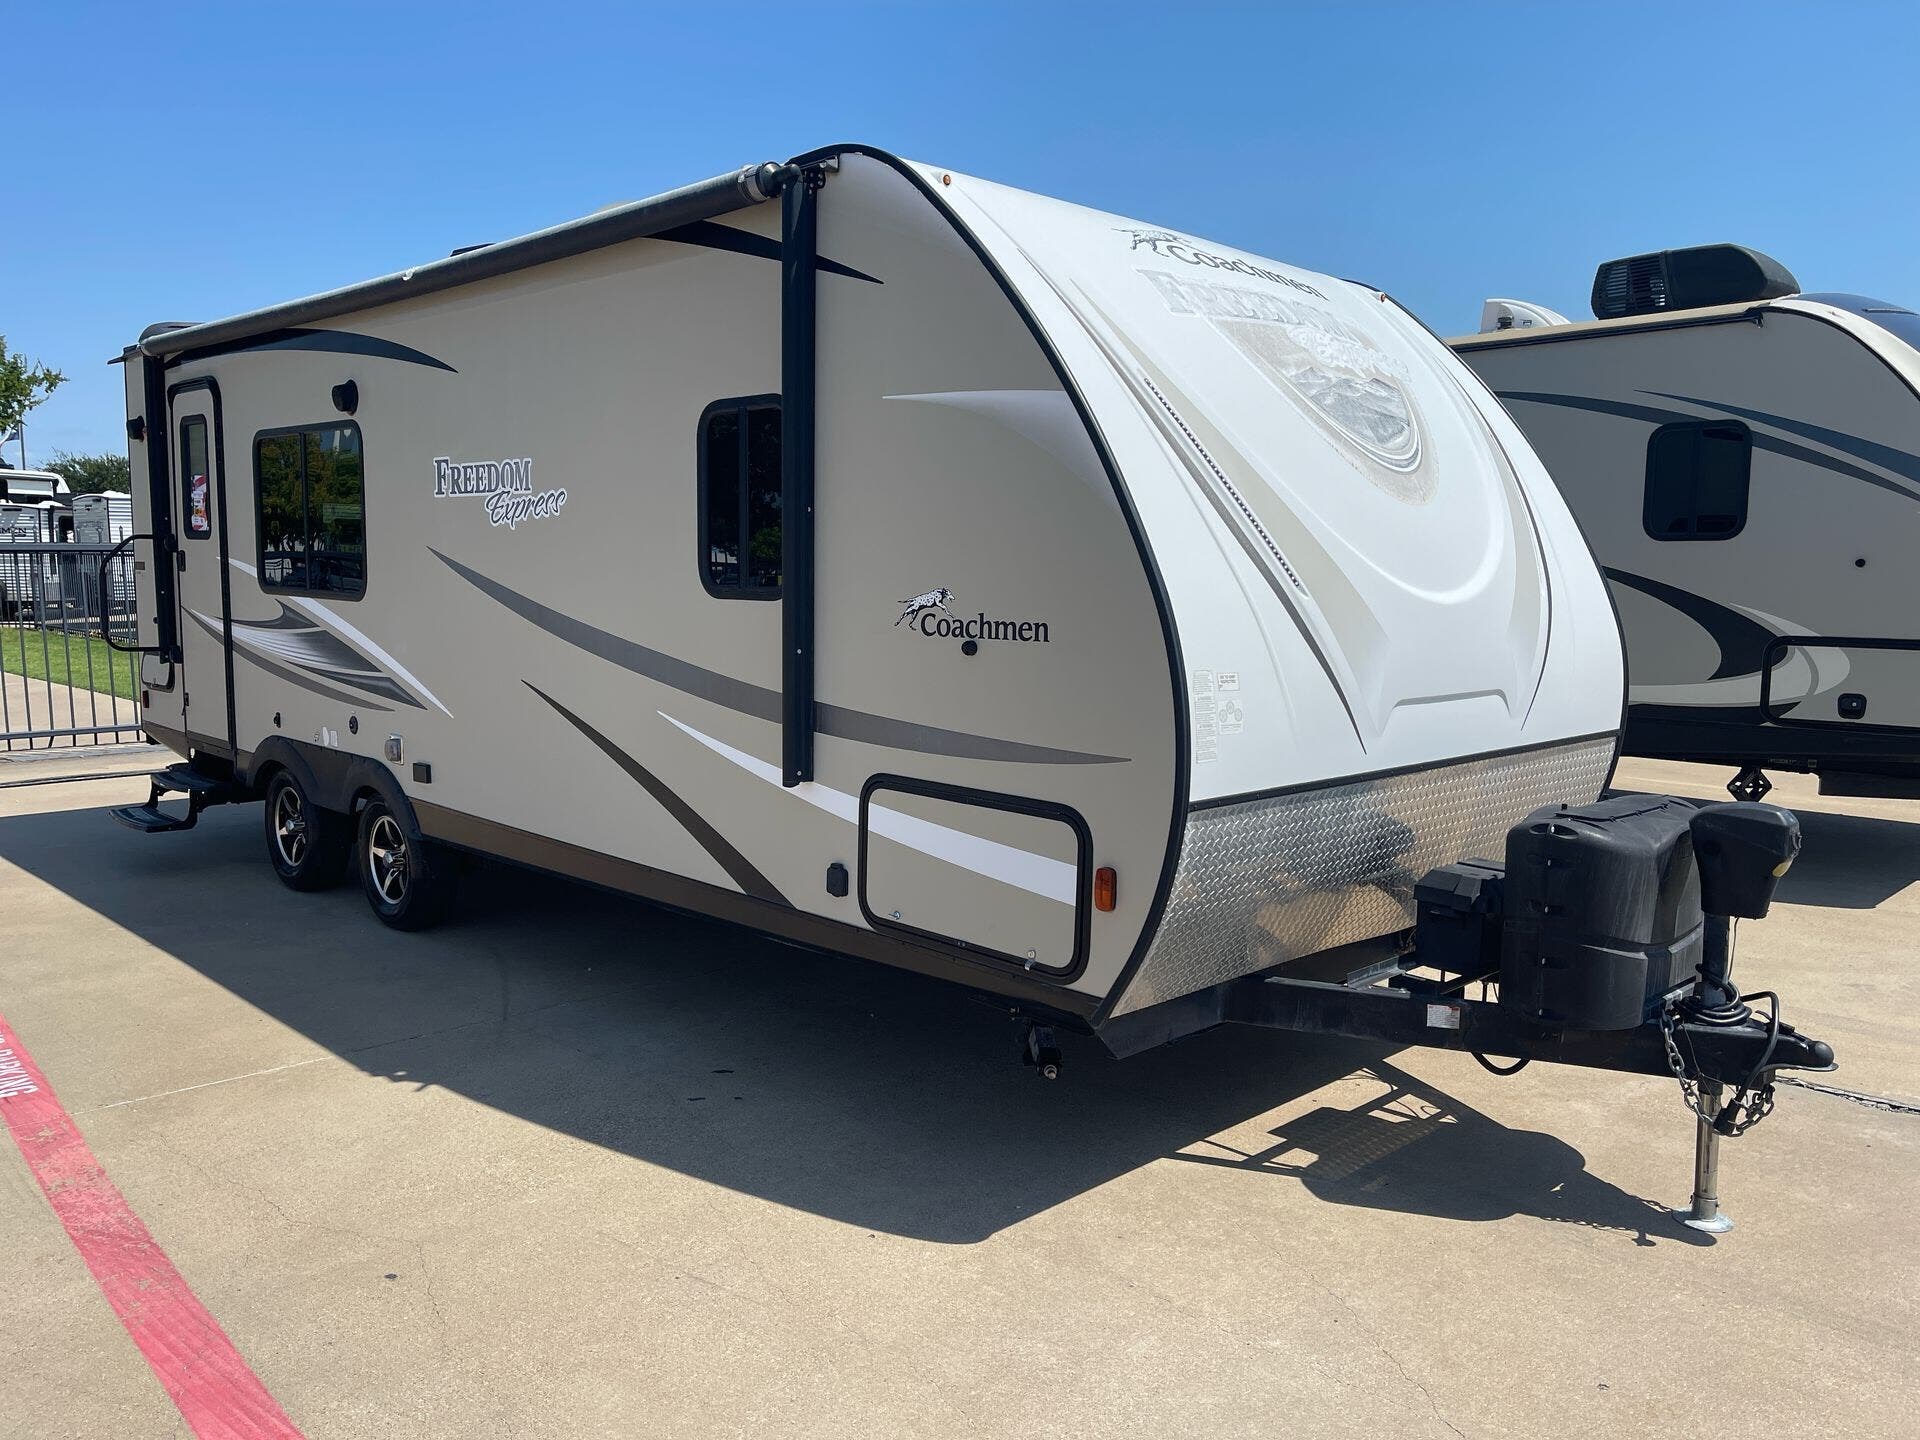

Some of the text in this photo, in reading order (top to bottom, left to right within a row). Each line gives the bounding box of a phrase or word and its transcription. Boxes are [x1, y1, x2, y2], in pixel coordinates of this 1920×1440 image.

[1166, 245, 1329, 301] Coachmen
[434, 457, 531, 496] FREEDOM
[486, 489, 566, 529] Express
[920, 612, 1050, 643] Coachmen
